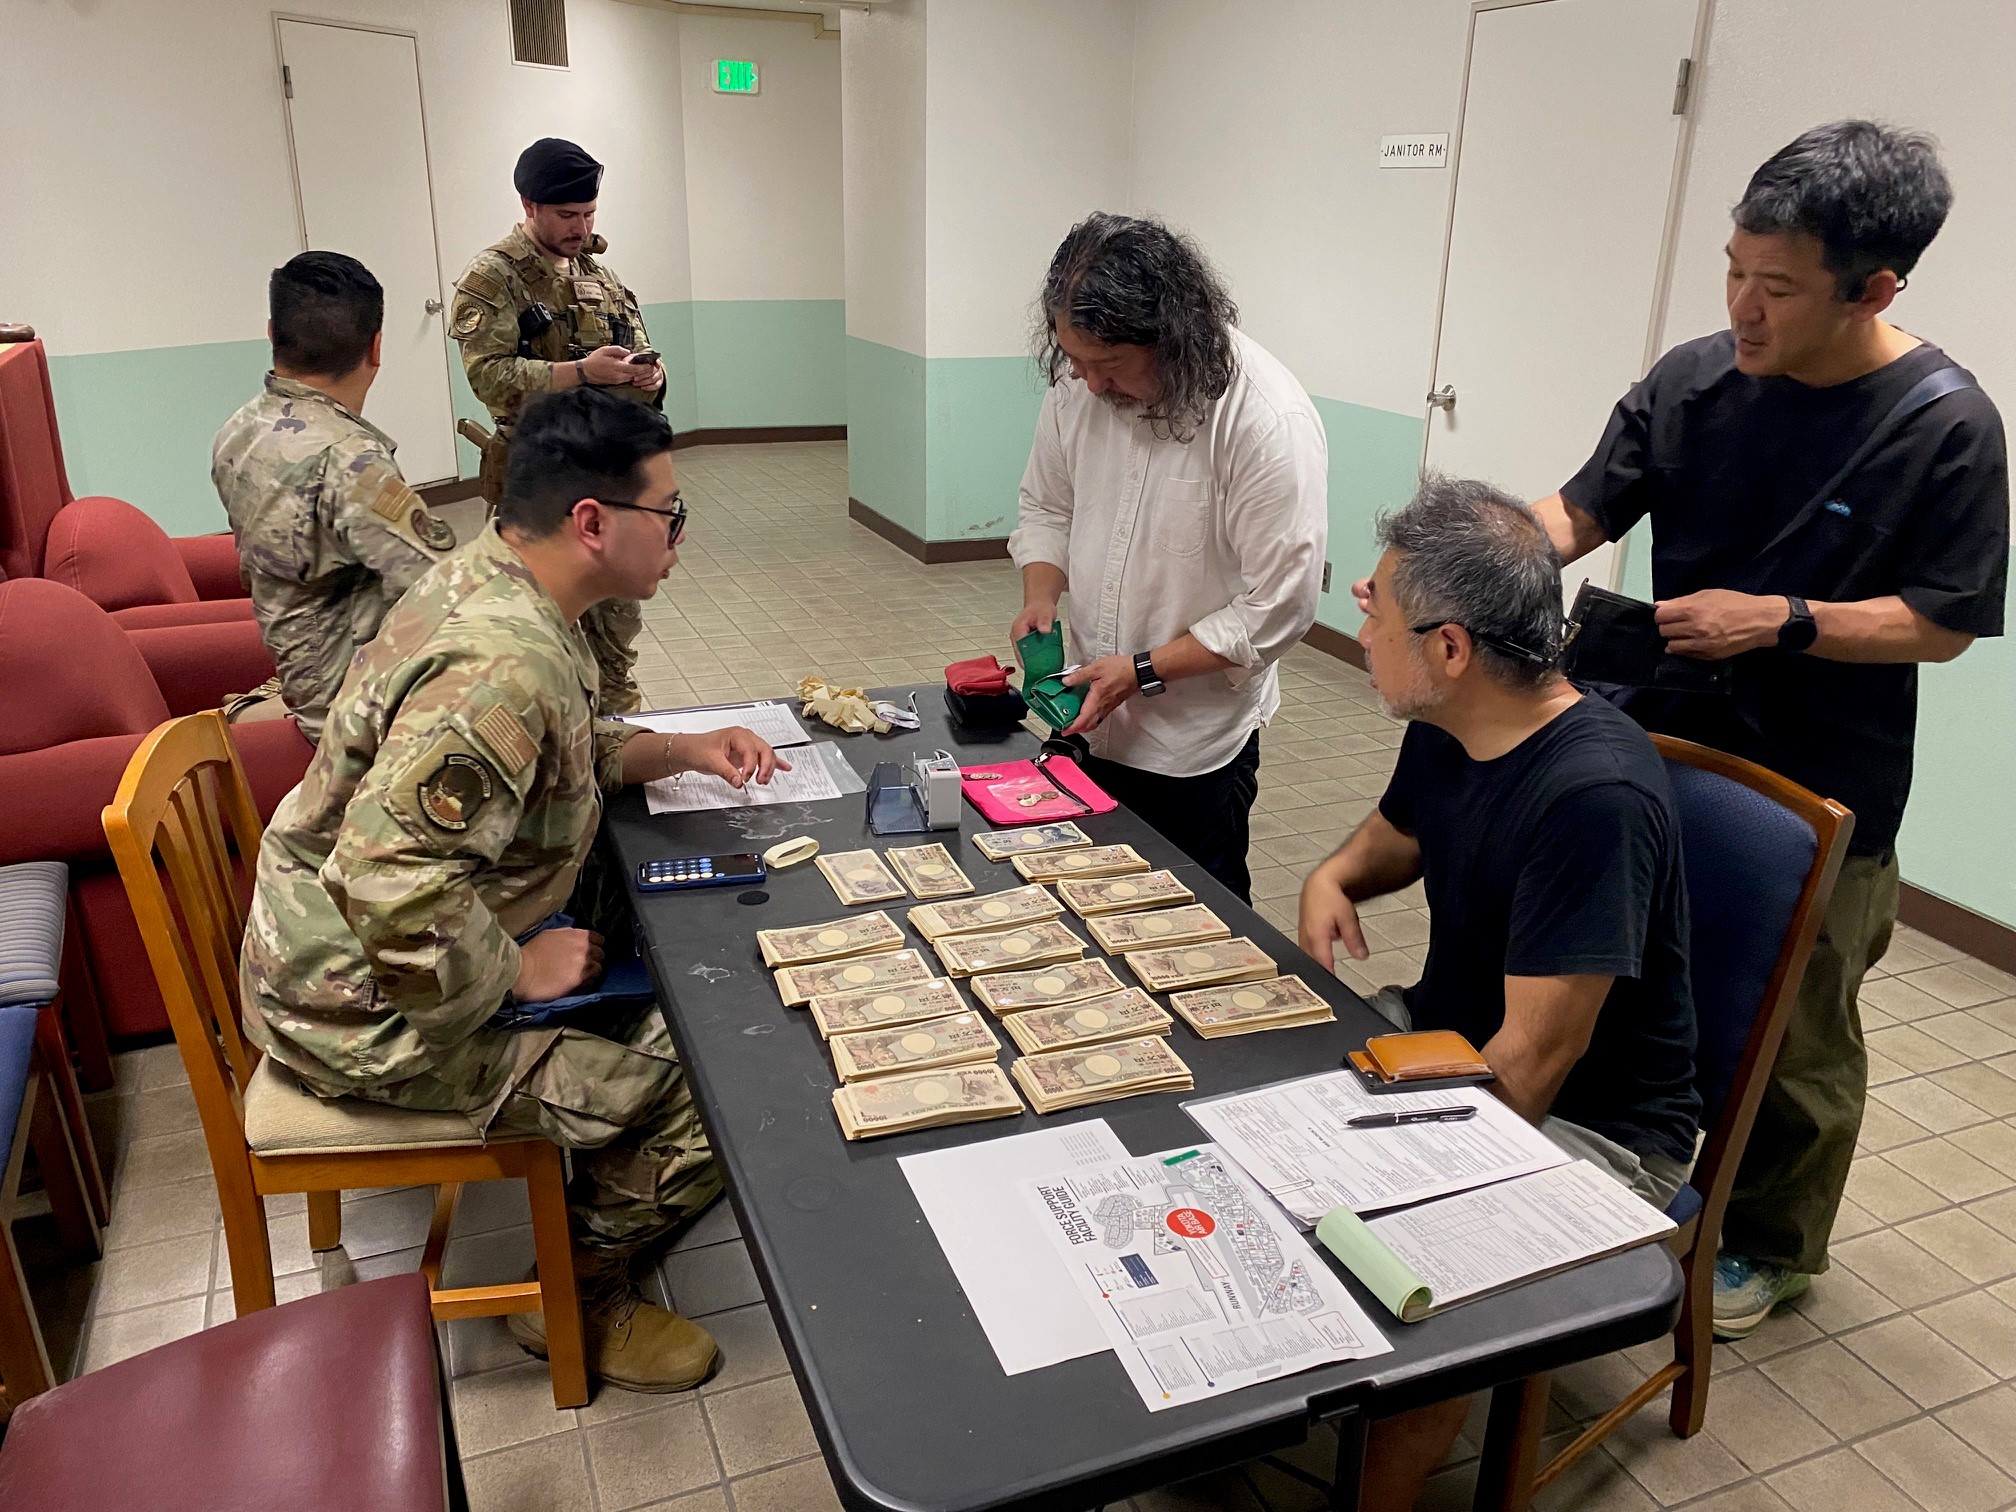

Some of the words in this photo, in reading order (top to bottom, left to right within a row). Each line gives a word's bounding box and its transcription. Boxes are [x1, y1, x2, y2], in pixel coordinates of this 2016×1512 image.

[1384, 144, 1425, 157] JANITOR
[1428, 144, 1443, 156] RM
[1037, 1186, 1068, 1220] SUPPORT
[1052, 1185, 1075, 1210] GUIDE
[1059, 1219, 1084, 1245] FORCE
[1066, 1210, 1098, 1242] FACILITY
[1221, 1281, 1241, 1309] RUNWAY
